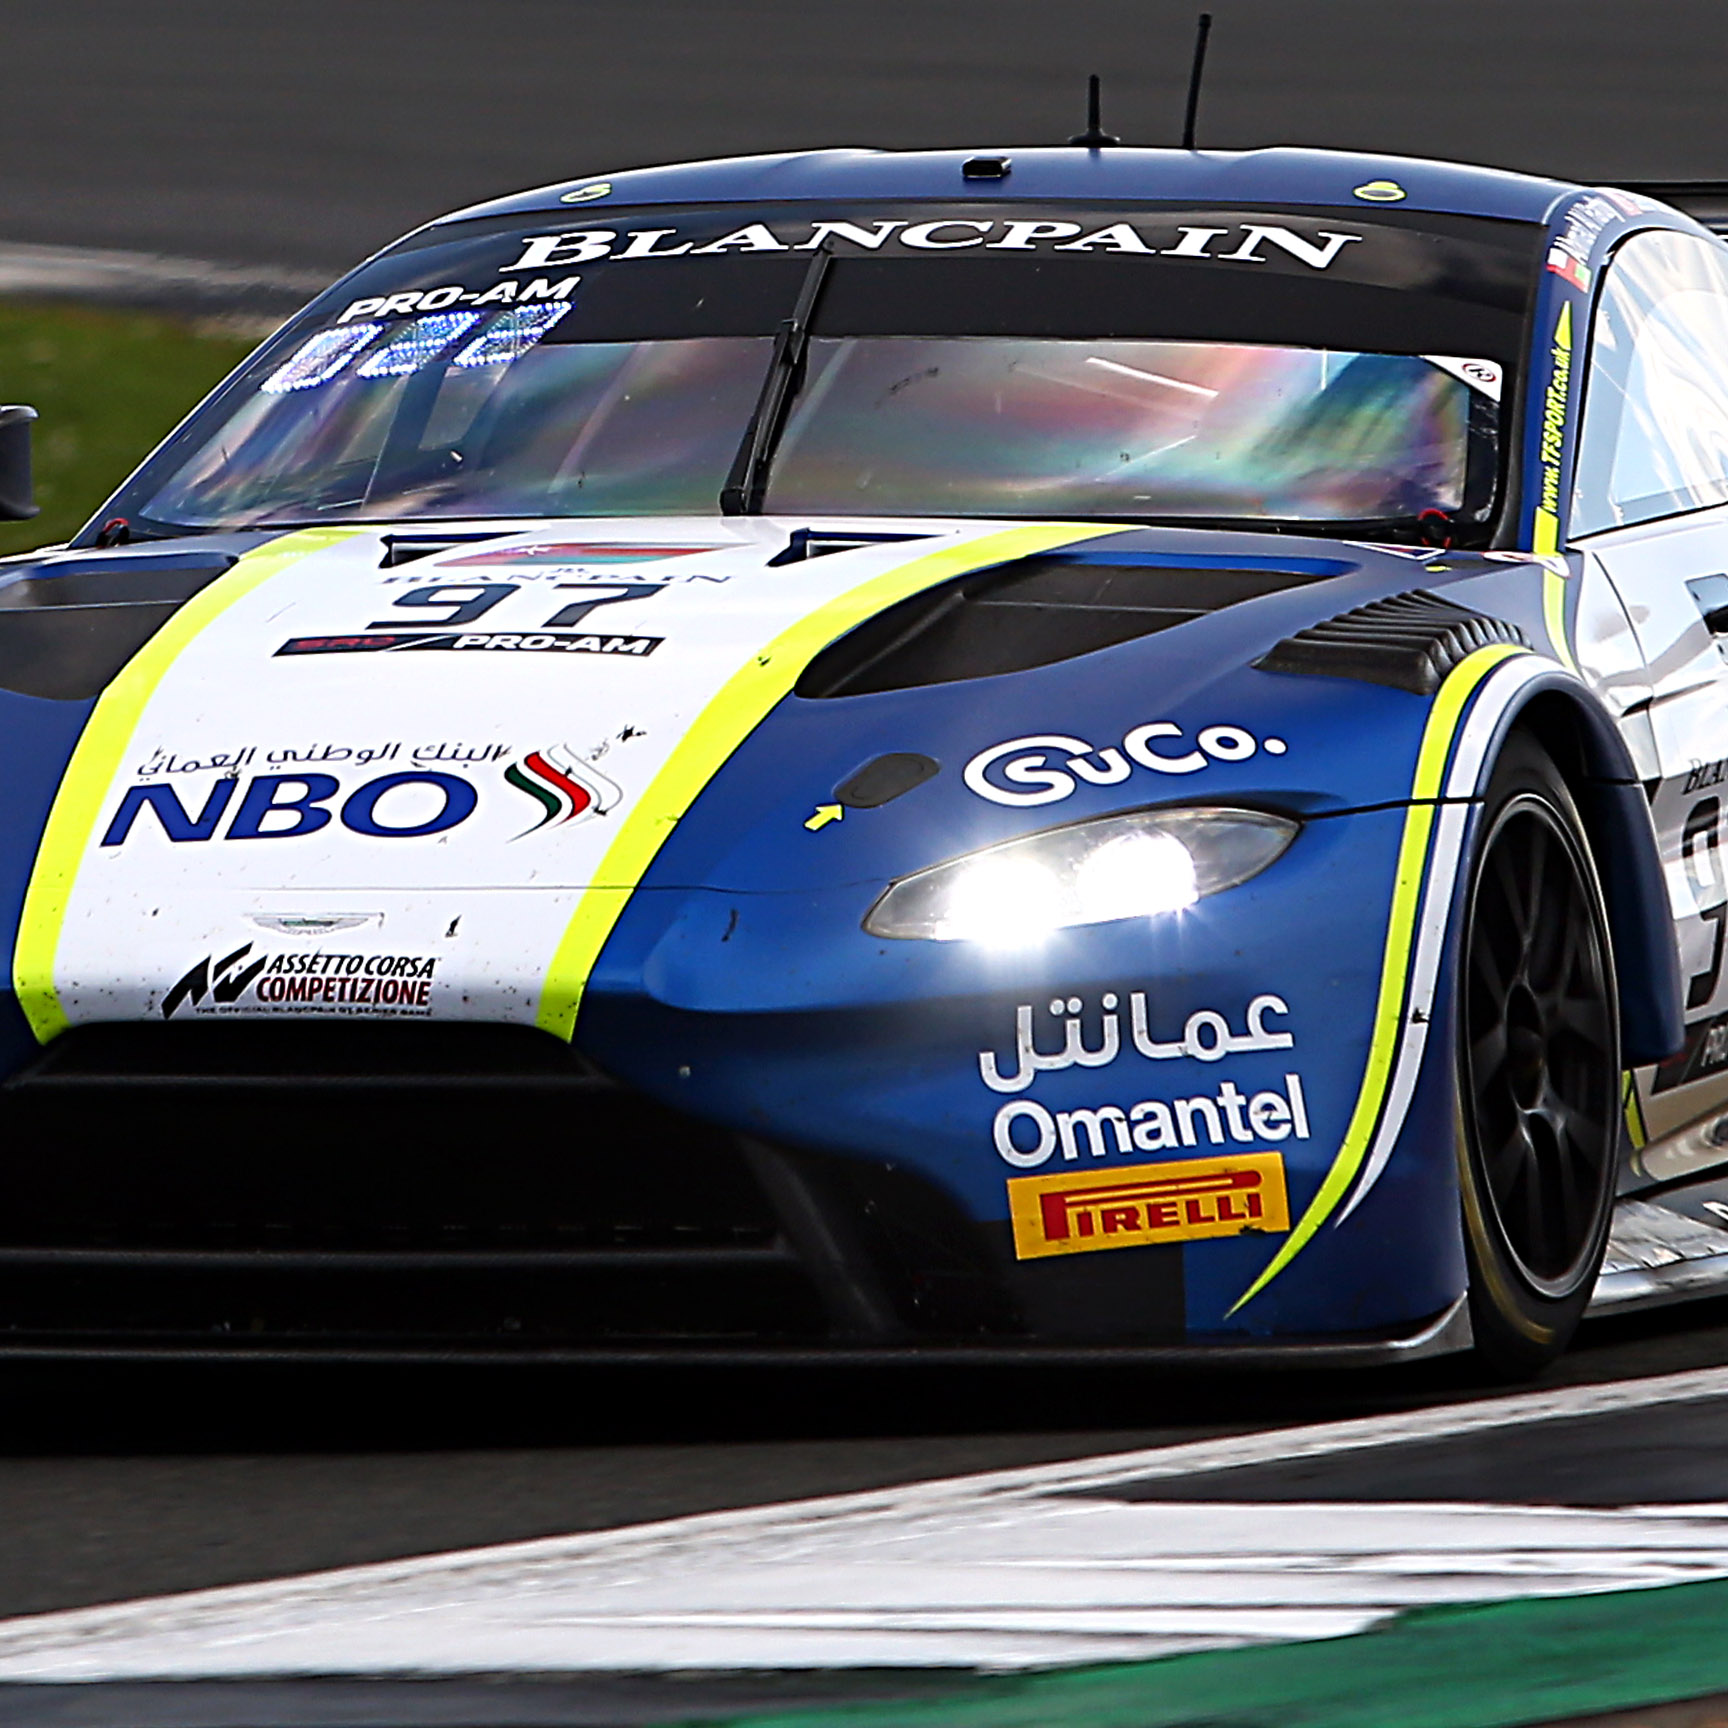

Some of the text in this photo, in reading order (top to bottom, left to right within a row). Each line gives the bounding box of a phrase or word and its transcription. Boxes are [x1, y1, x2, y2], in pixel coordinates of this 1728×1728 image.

[498, 217, 1362, 273] BLANCPAIN
[337, 276, 580, 324] PRO-AM
[1541, 346, 1571, 513] www.TFSPORT.co.uk
[365, 583, 669, 630] 97
[454, 635, 653, 654] PRO-AM
[267, 742, 402, 770] الوطني
[100, 771, 478, 847] NBO
[256, 977, 432, 1006] COMPETIZIONE
[267, 952, 436, 979] ASSETTO CORSA
[979, 992, 1294, 1093] عمانتل
[993, 1073, 1311, 1168] Omantel
[1038, 1169, 1265, 1242] PIRELLI
